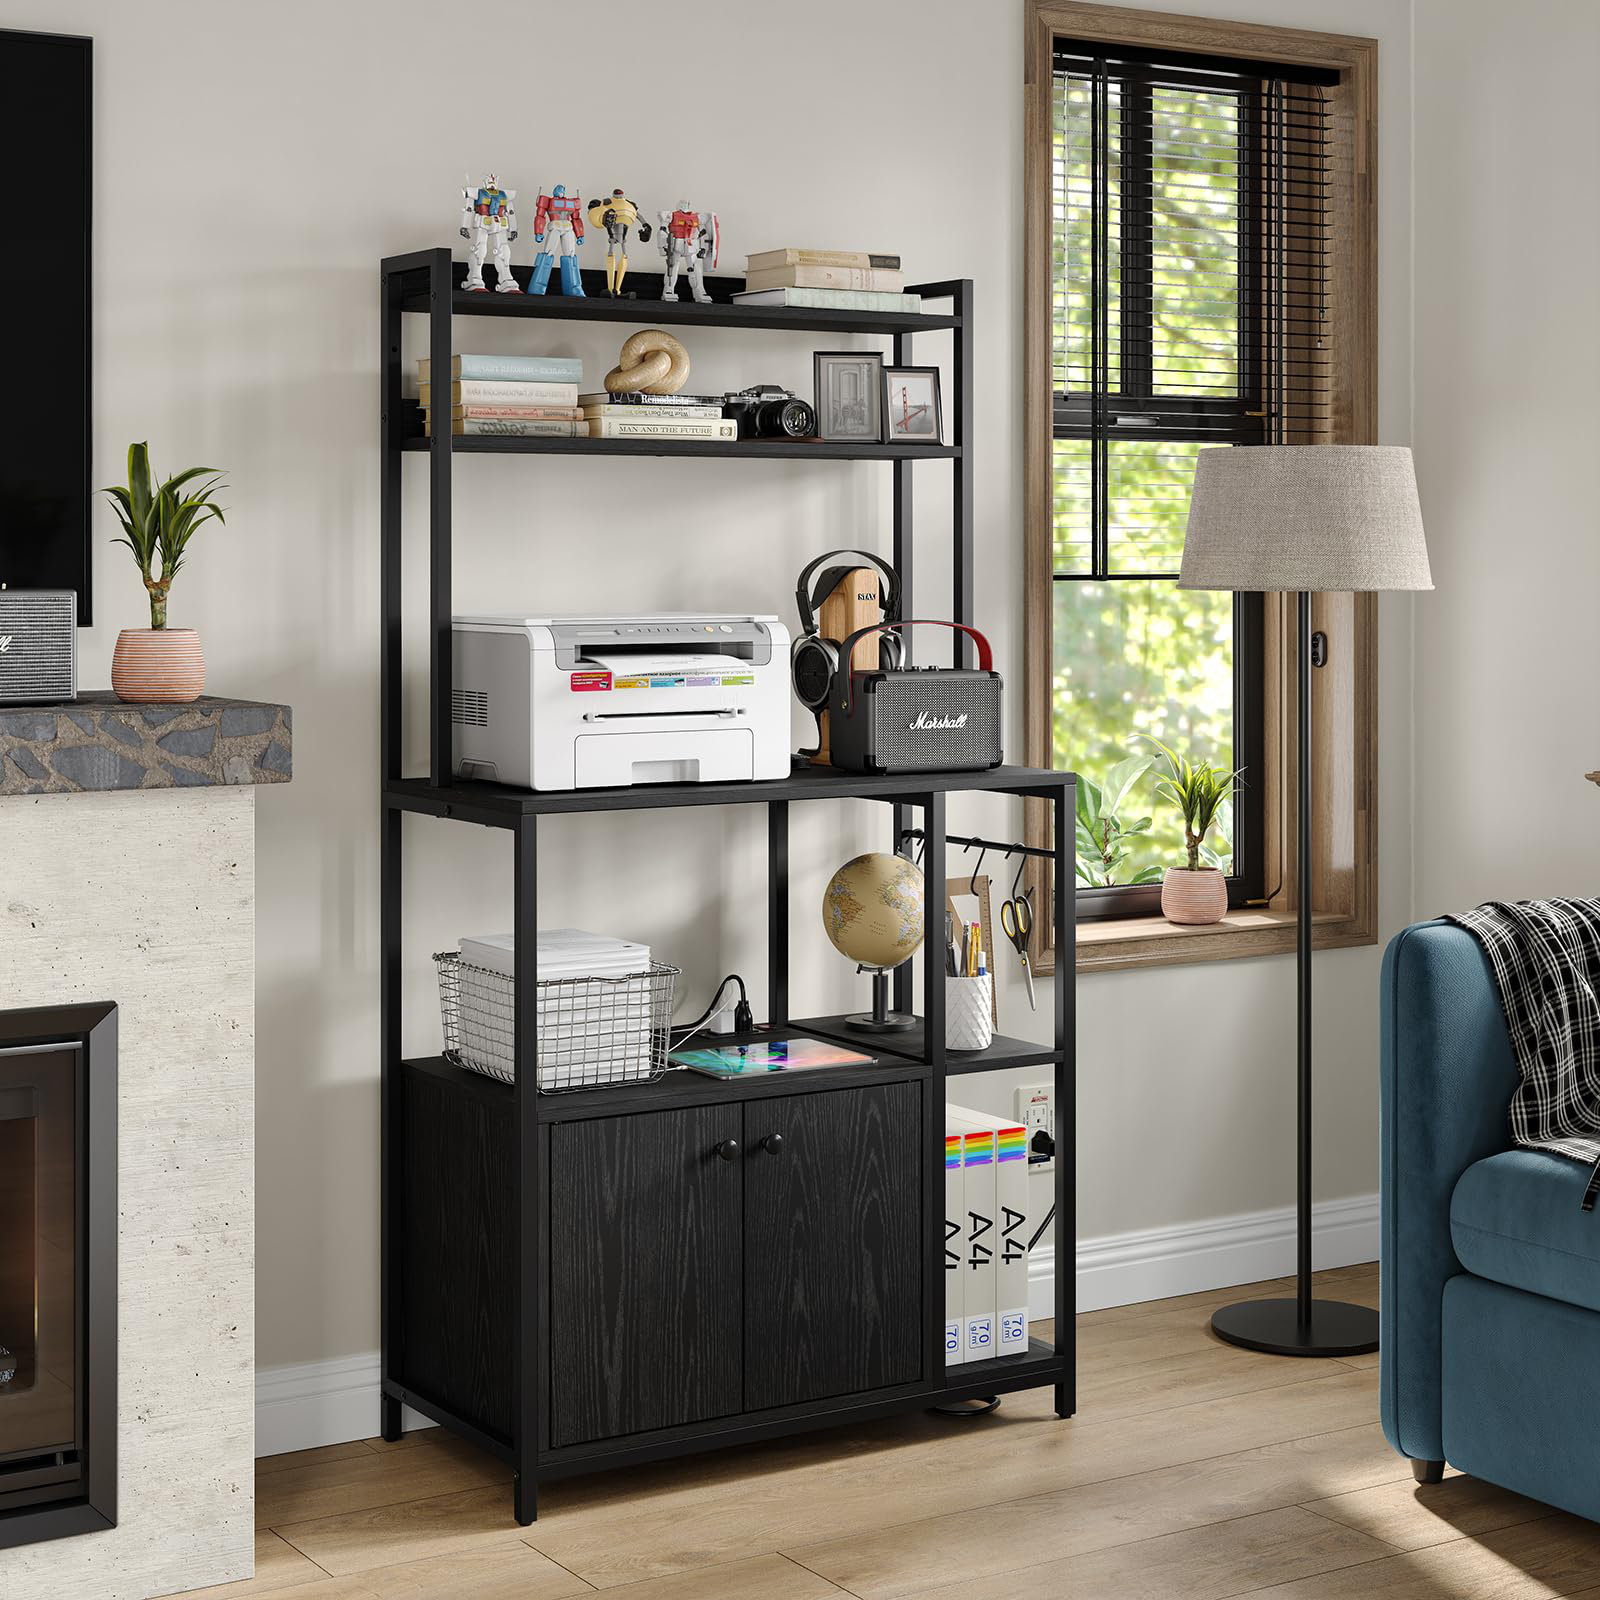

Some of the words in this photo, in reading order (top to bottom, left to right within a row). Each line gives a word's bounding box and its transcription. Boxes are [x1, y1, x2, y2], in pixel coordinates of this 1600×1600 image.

[642, 426, 659, 434] AND
[680, 427, 713, 435] FUTURE
[909, 711, 968, 729] Marshall
[968, 1211, 993, 1270] A4
[1001, 1206, 1026, 1265] A4
[979, 1322, 989, 1343] 70
[1012, 1316, 1022, 1338] 70
[946, 1328, 957, 1349] 70
